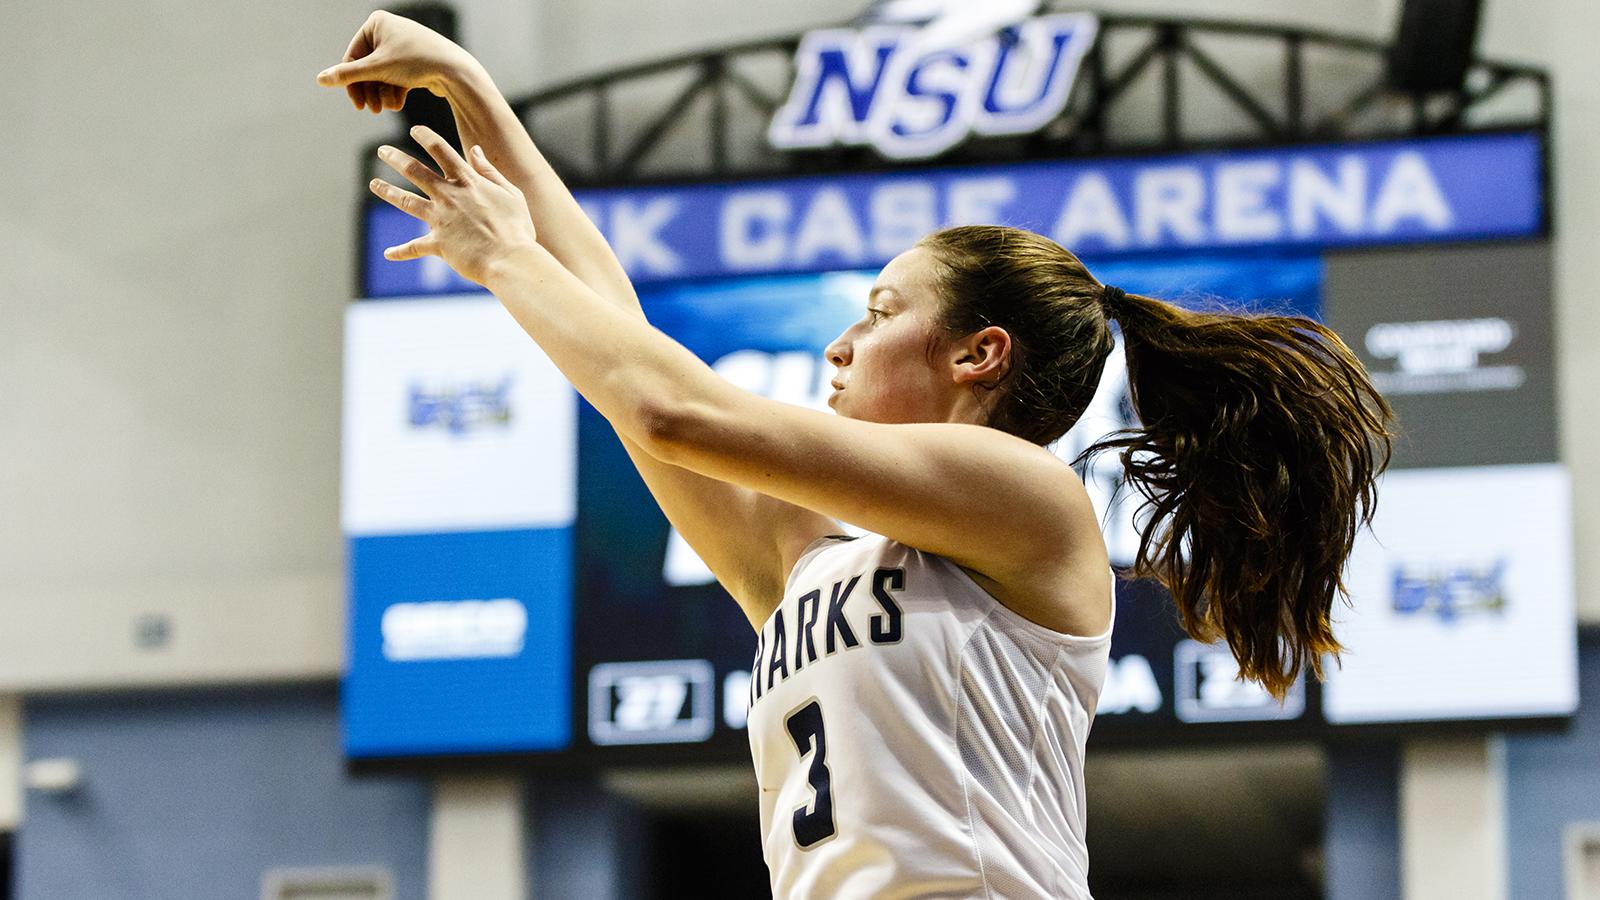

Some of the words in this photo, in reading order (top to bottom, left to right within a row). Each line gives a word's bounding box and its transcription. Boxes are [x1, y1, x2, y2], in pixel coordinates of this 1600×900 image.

[772, 14, 1094, 158] NSU
[719, 177, 1015, 268] CASE
[1053, 151, 1452, 249] ARENA
[749, 566, 906, 711] HARKS
[783, 696, 839, 851] 3
